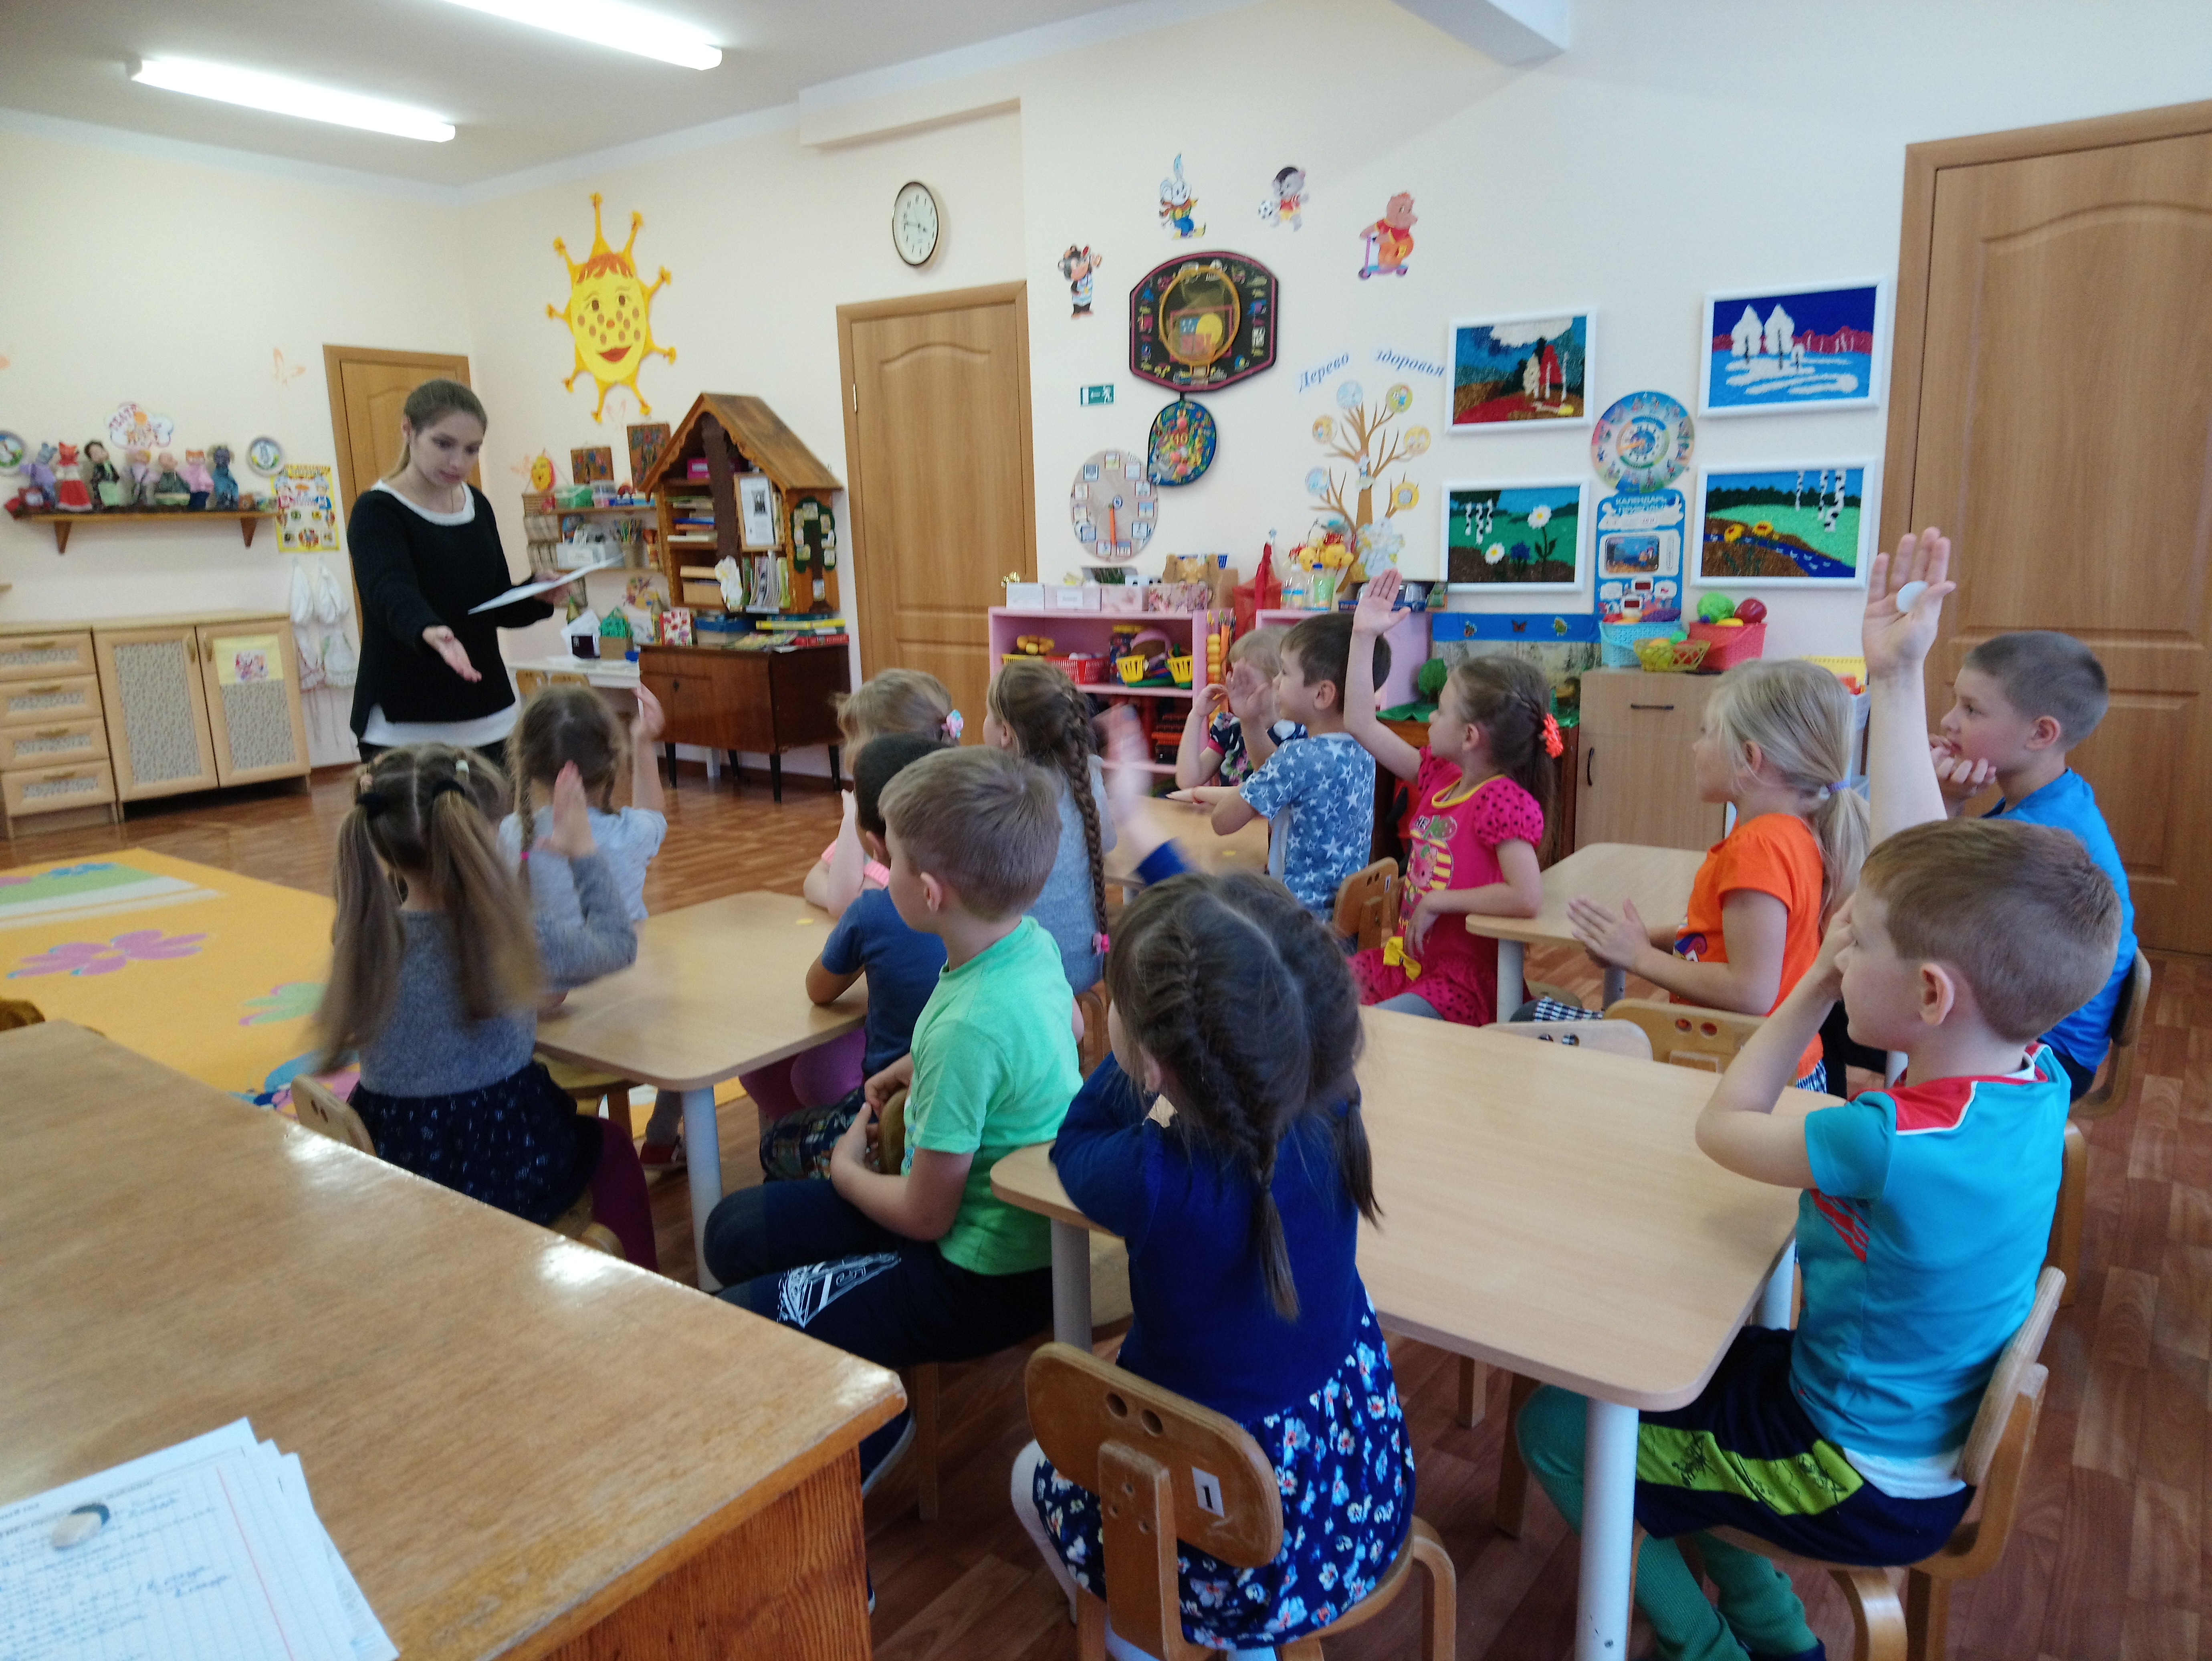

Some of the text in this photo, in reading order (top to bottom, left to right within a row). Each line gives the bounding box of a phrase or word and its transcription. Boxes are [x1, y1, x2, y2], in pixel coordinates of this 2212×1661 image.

[1299, 349, 1445, 393] Дерево здоровья
[1202, 1485, 1213, 1509] 1
